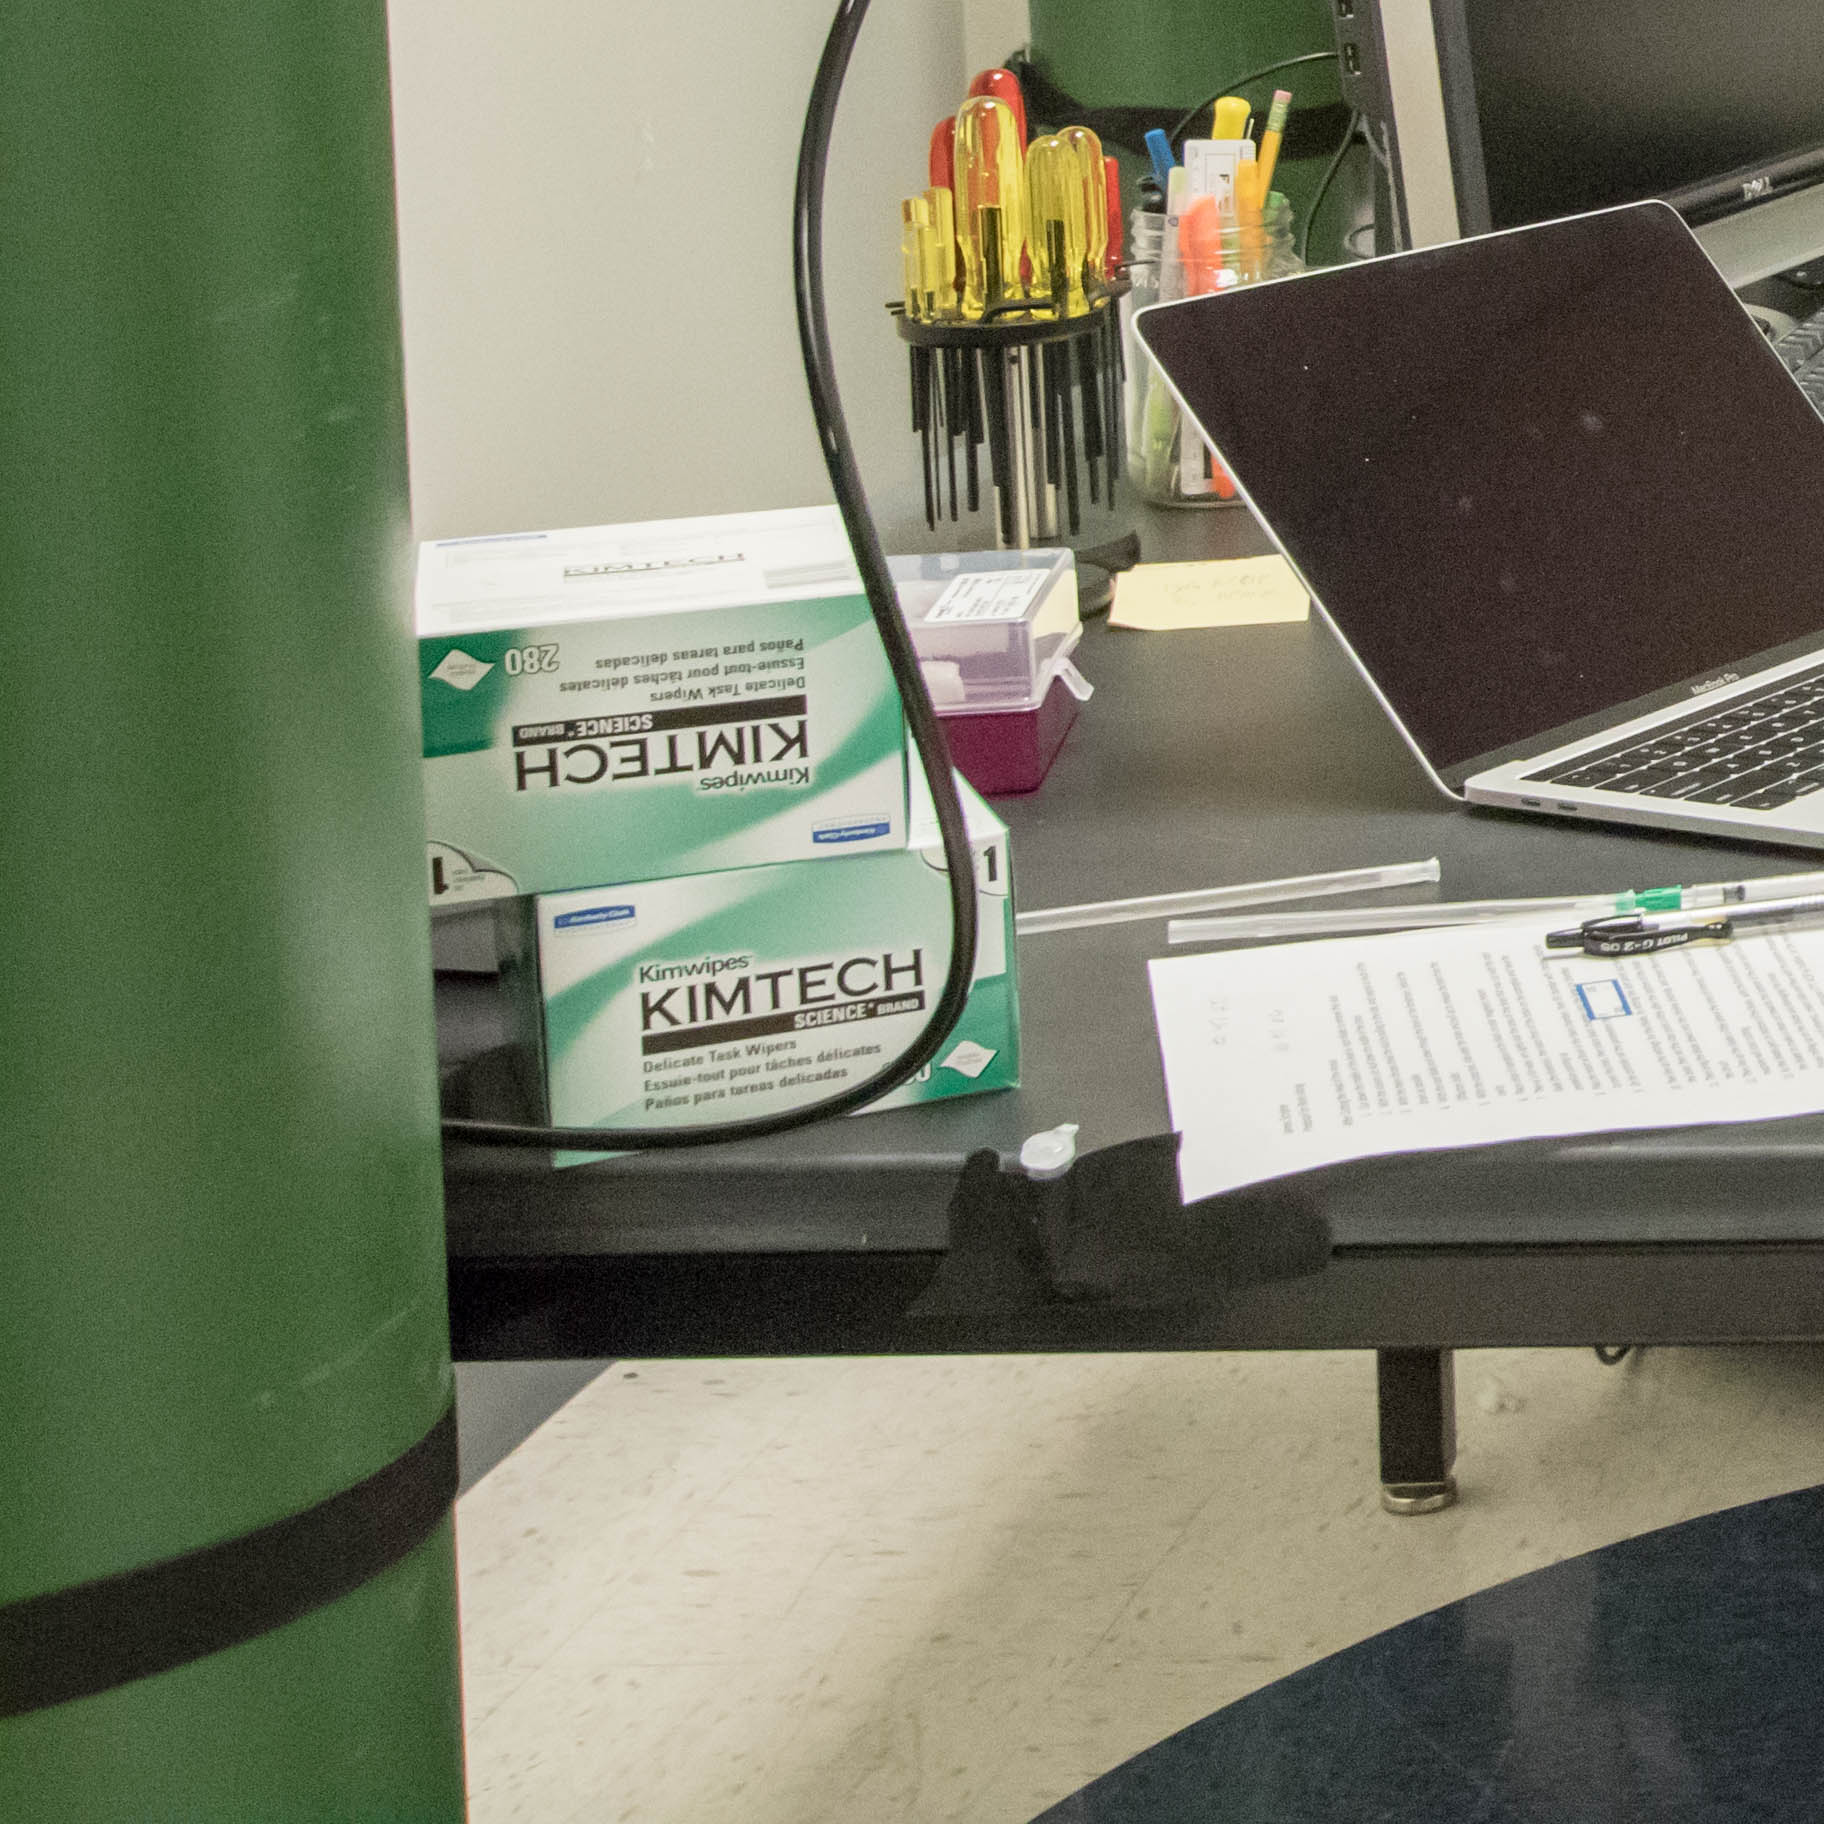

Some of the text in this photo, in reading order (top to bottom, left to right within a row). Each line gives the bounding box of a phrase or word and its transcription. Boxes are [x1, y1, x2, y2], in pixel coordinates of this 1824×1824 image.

[504, 643, 560, 676] 280
[596, 650, 668, 670] delicadas
[672, 645, 719, 659] tareas
[723, 641, 756, 656] para
[687, 664, 720, 680] pour
[724, 657, 805, 677] Essuie-tout
[650, 676, 805, 702] Delicate Task Wipers
[515, 719, 809, 792] KIMTECH
[699, 767, 809, 791] Kimwipes
[432, 857, 449, 895] 1
[983, 846, 997, 882] 1
[1623, 939, 1655, 952] G-2
[1657, 932, 1689, 946] PILOT
[639, 955, 750, 983] Kimwipes
[641, 948, 924, 1031] KIMTECH
[877, 998, 920, 1016] BRAND
[642, 1040, 797, 1073] Delicate Task Wipers
[644, 1070, 727, 1092] Essuie-tout
[730, 1065, 762, 1082] pour
[645, 1066, 848, 1111] Paños para tareas delicadas
